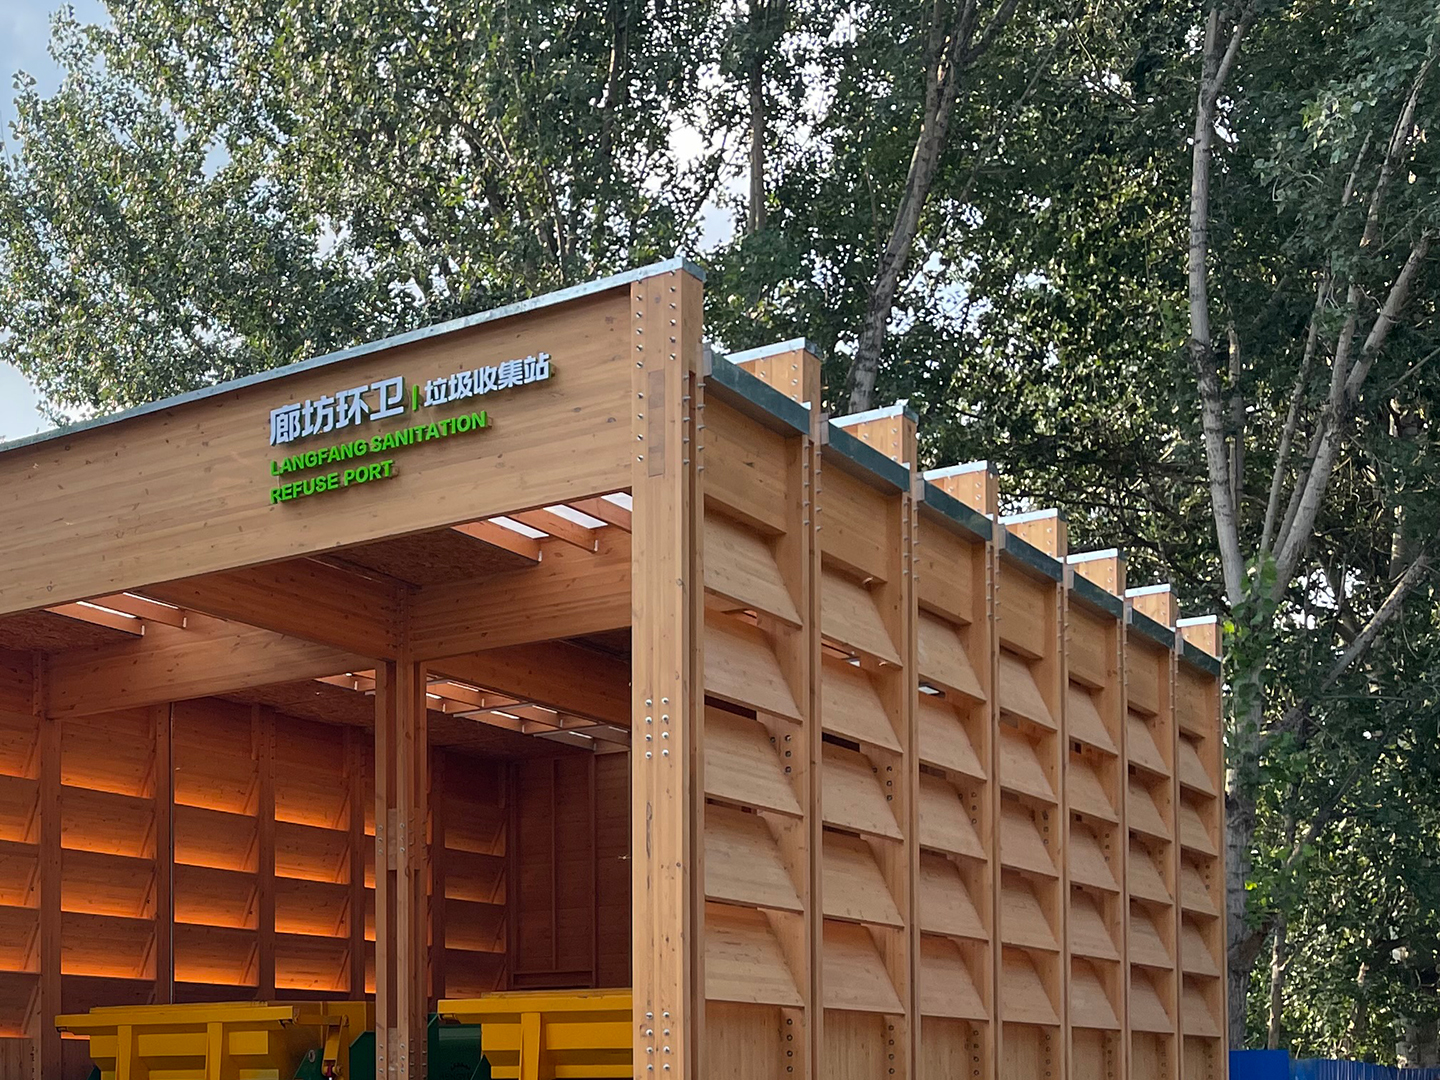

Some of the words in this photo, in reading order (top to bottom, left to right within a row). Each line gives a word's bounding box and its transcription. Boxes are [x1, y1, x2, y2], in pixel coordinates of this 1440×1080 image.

[269, 375, 405, 446] 廊坊环卫
[423, 352, 551, 407] 垃圾收集站
[270, 439, 367, 477] LANGFANG
[370, 410, 488, 453] SANITATION
[270, 471, 339, 504] REFUSE
[343, 459, 394, 487] PORT
